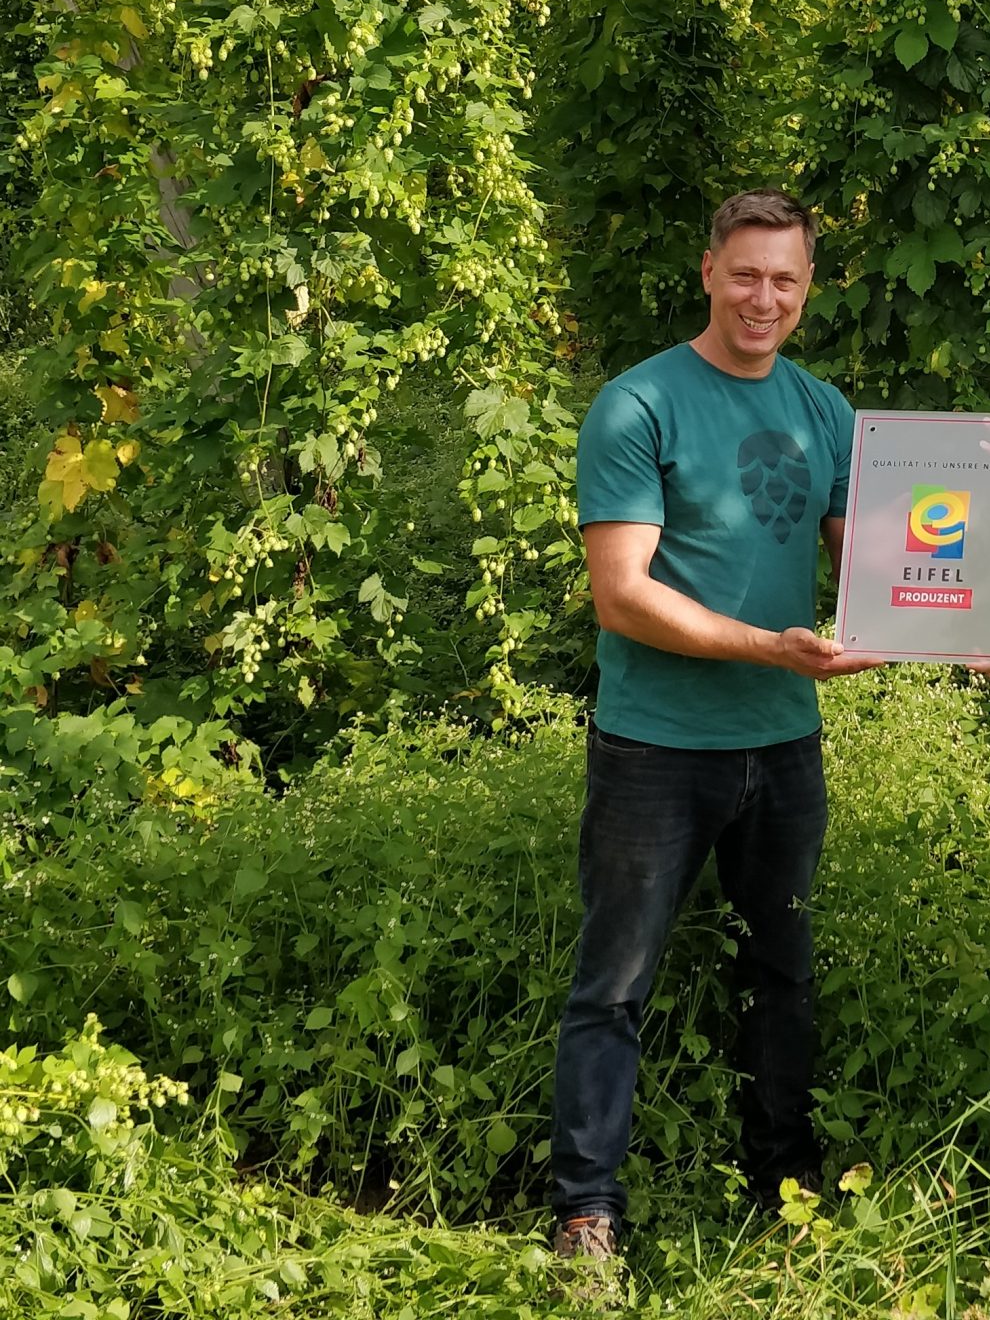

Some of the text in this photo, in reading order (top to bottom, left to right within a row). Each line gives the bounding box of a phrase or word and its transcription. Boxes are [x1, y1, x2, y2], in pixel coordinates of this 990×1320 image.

[923, 461, 938, 469] IST
[942, 462, 979, 470] UNSERE
[903, 567, 963, 582] EIFEL
[898, 591, 965, 604] PRODUZENT
